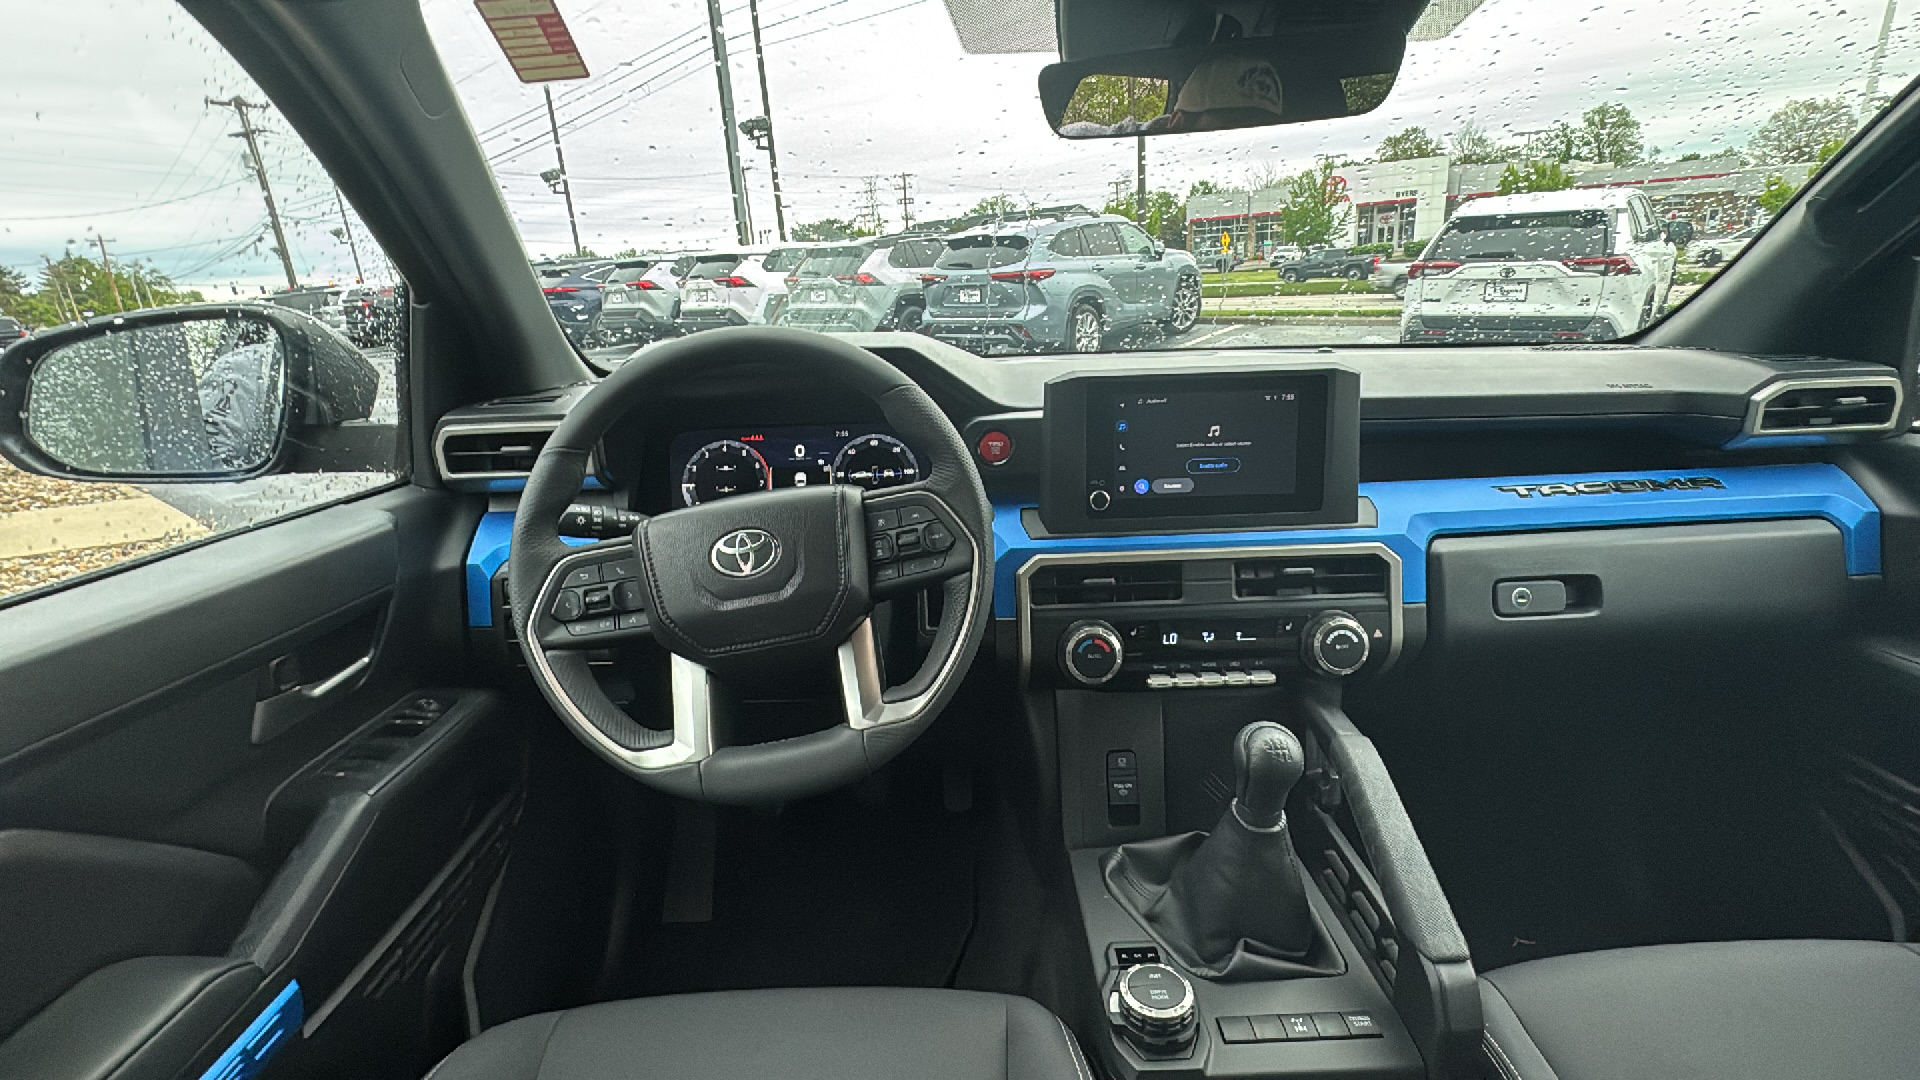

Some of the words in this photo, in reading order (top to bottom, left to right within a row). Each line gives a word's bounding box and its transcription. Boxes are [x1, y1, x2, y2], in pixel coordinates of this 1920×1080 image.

[1395, 190, 1418, 198] BYERS
[1490, 477, 1726, 499] TACOMA
[1162, 632, 1178, 645] LO
